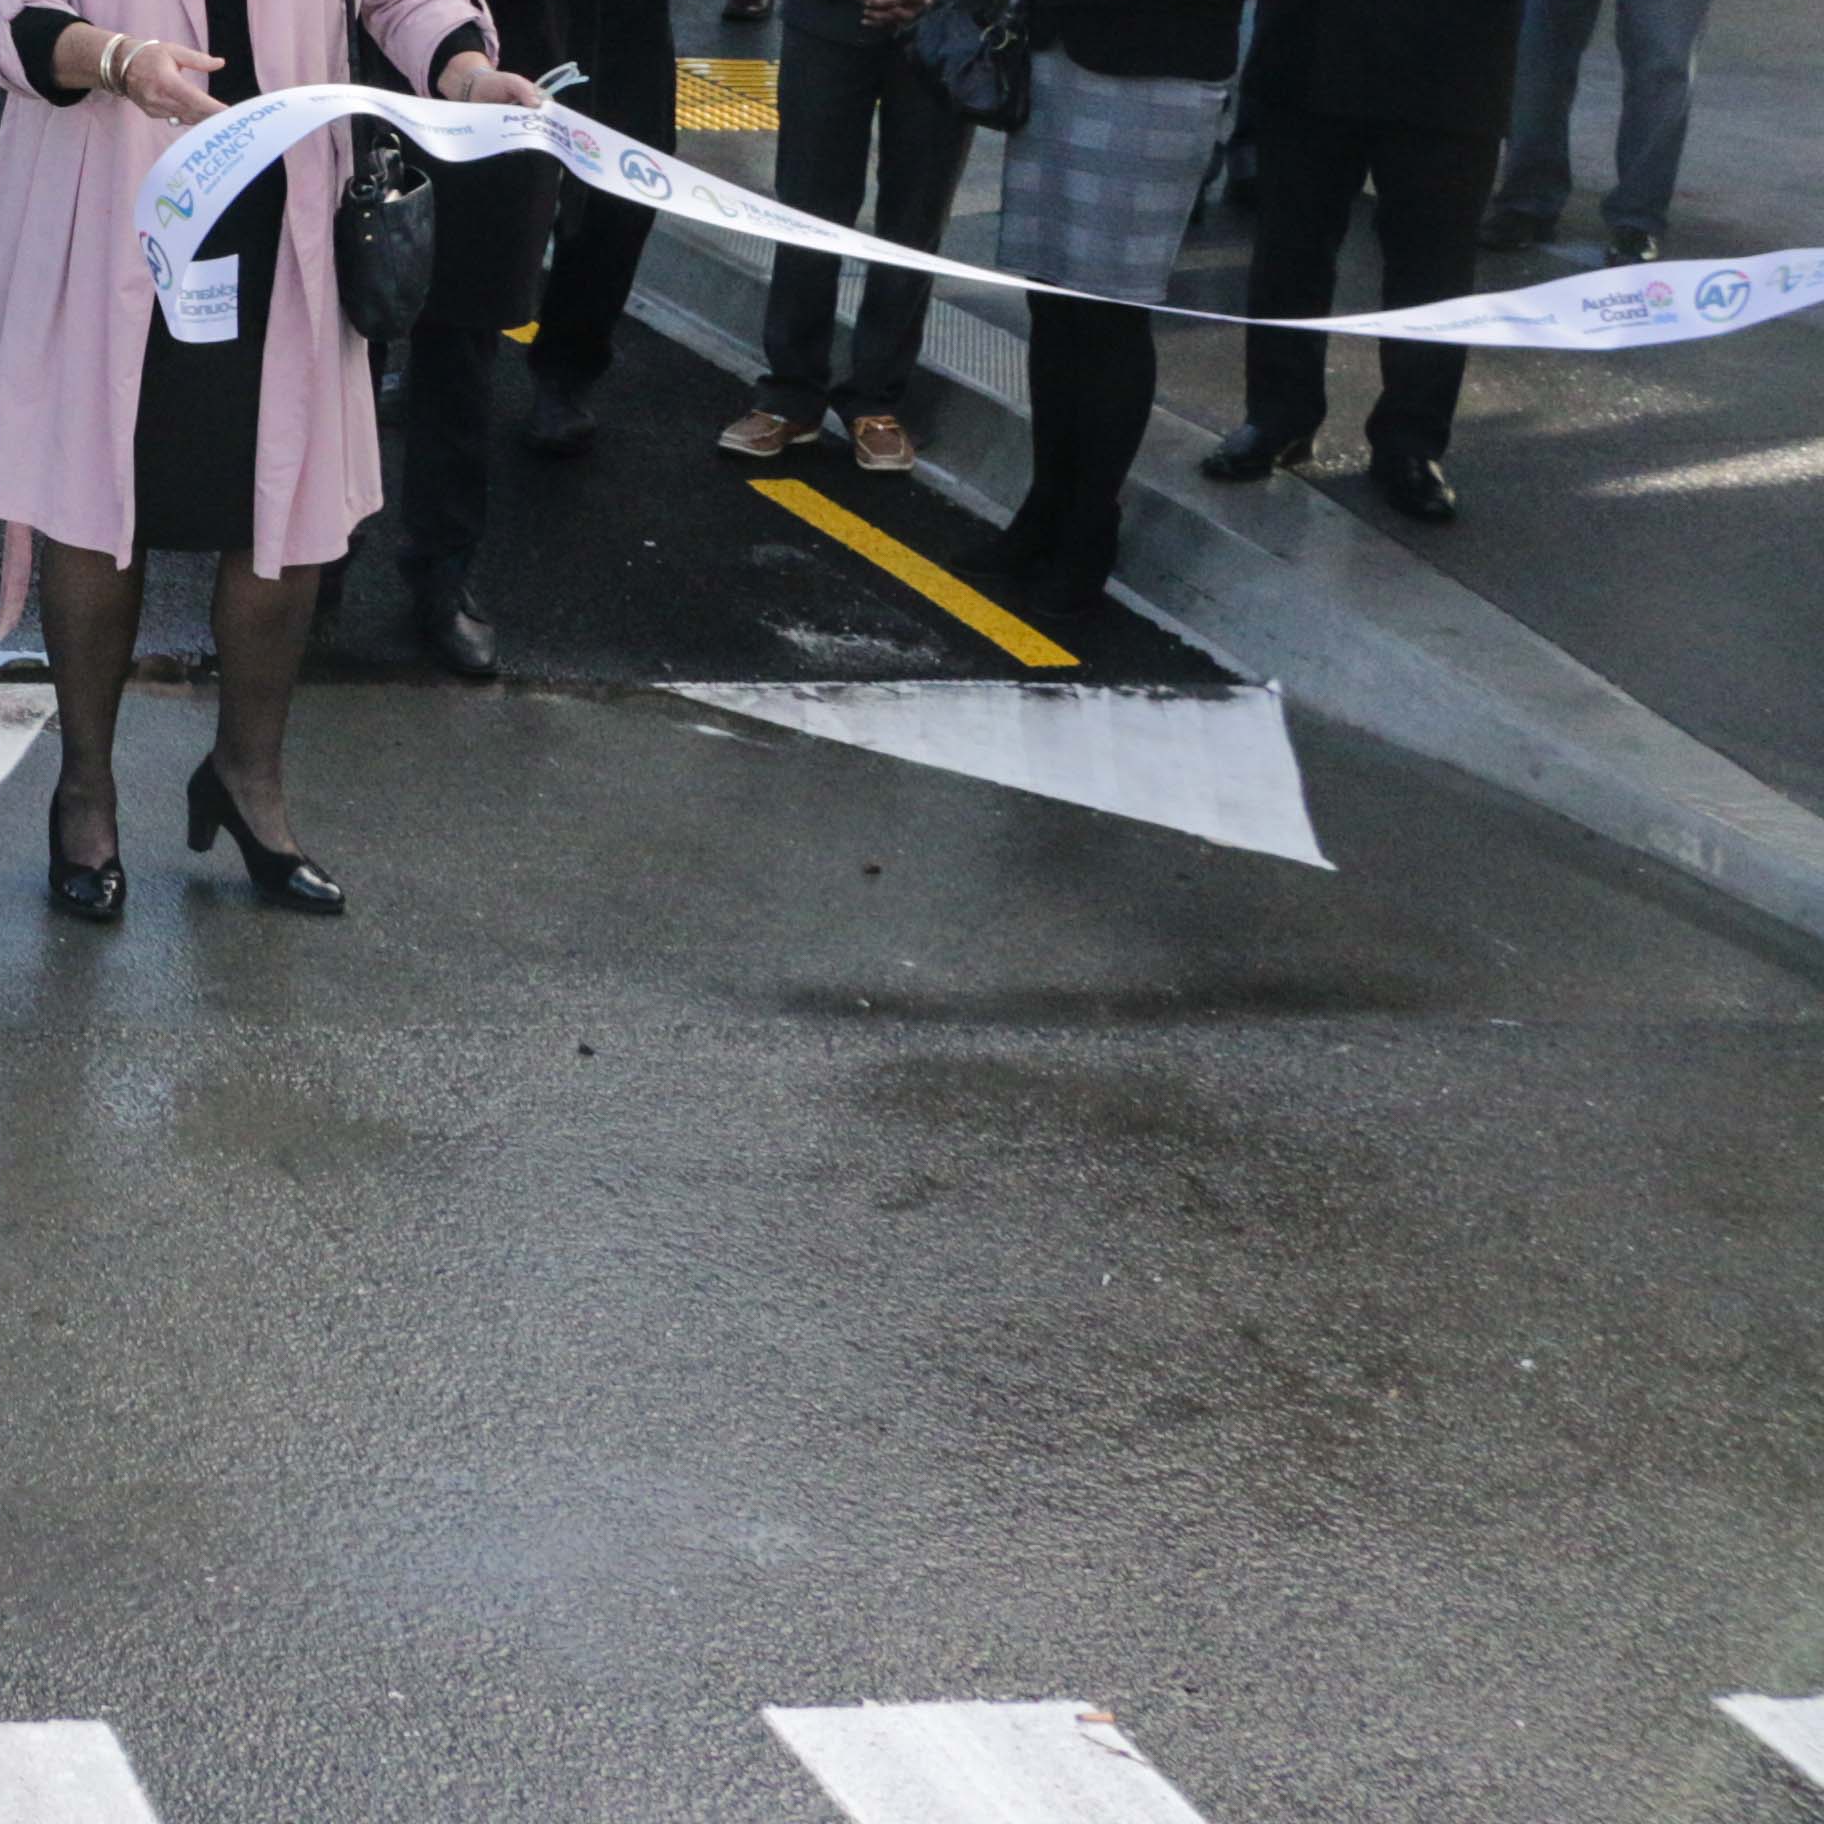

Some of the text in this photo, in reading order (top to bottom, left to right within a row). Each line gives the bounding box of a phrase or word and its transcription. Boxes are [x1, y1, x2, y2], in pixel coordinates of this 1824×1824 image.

[182, 99, 288, 173] TRANSPORT
[194, 127, 256, 189] AGENCY
[1581, 289, 1646, 312] Auckland
[1599, 303, 1648, 323] Council
